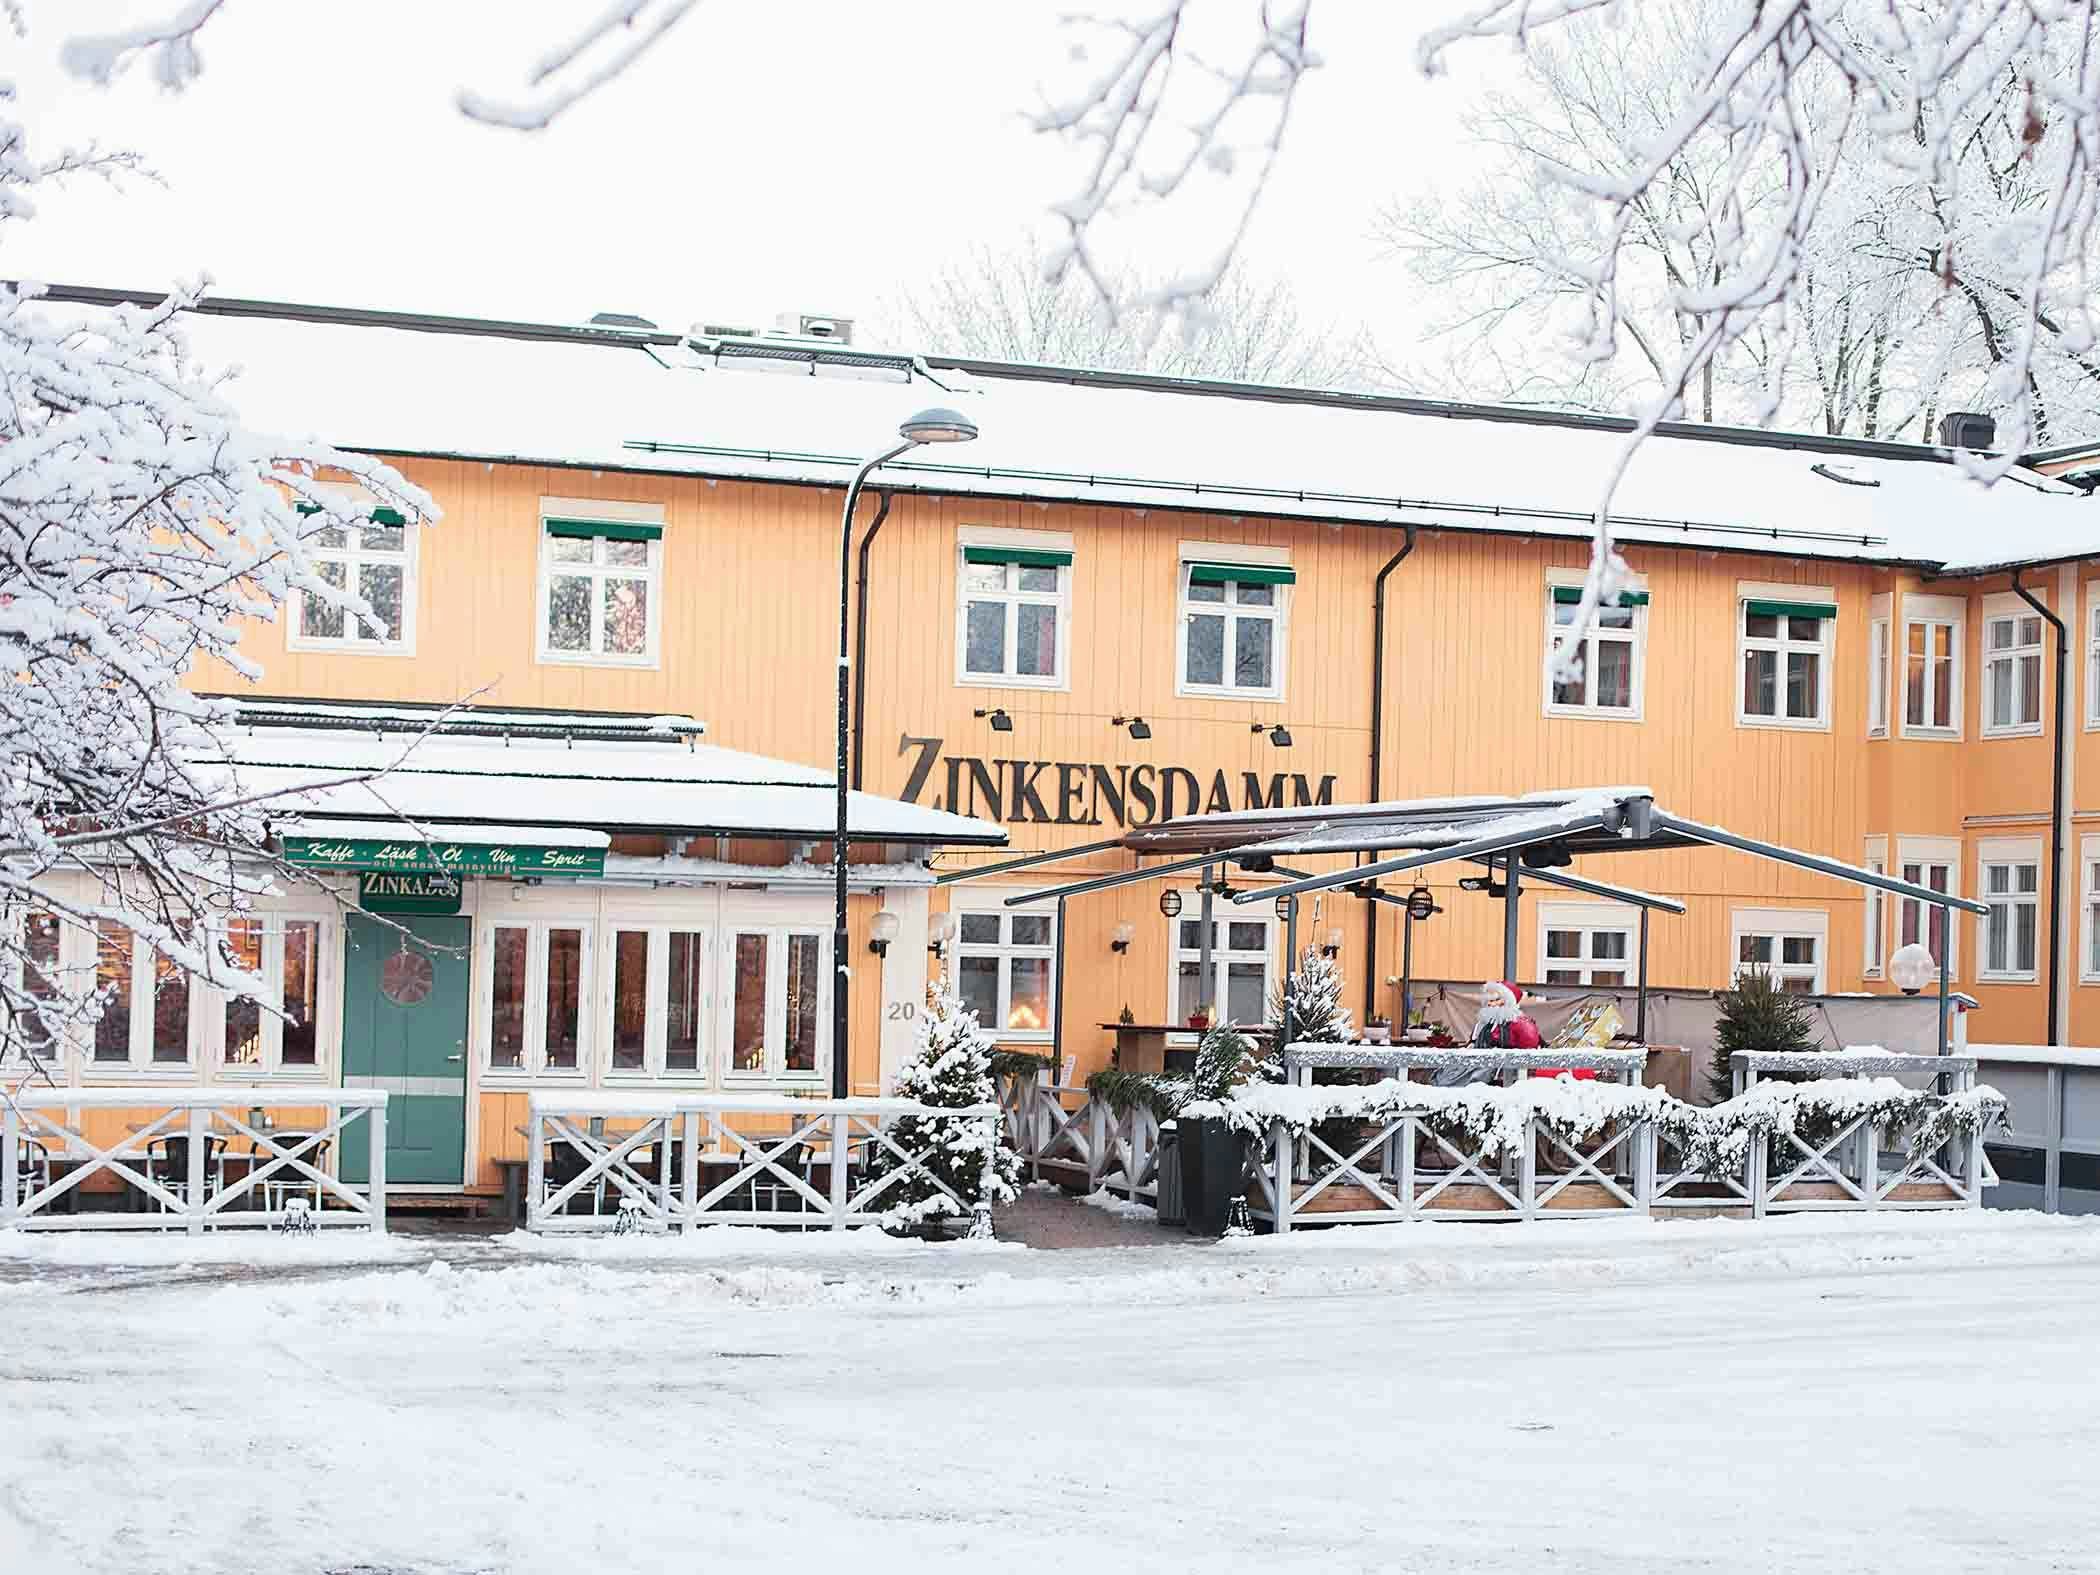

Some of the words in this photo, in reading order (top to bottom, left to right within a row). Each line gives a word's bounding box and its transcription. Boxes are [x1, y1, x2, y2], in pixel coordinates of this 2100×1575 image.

[898, 733, 1337, 827] ZINKENSDAMM
[307, 842, 355, 861] Kaffe
[373, 844, 417, 861] Läsk
[441, 844, 463, 862] Öl
[488, 847, 516, 863] Vin
[541, 849, 585, 868] Sprit
[888, 1001, 914, 1020] 20
